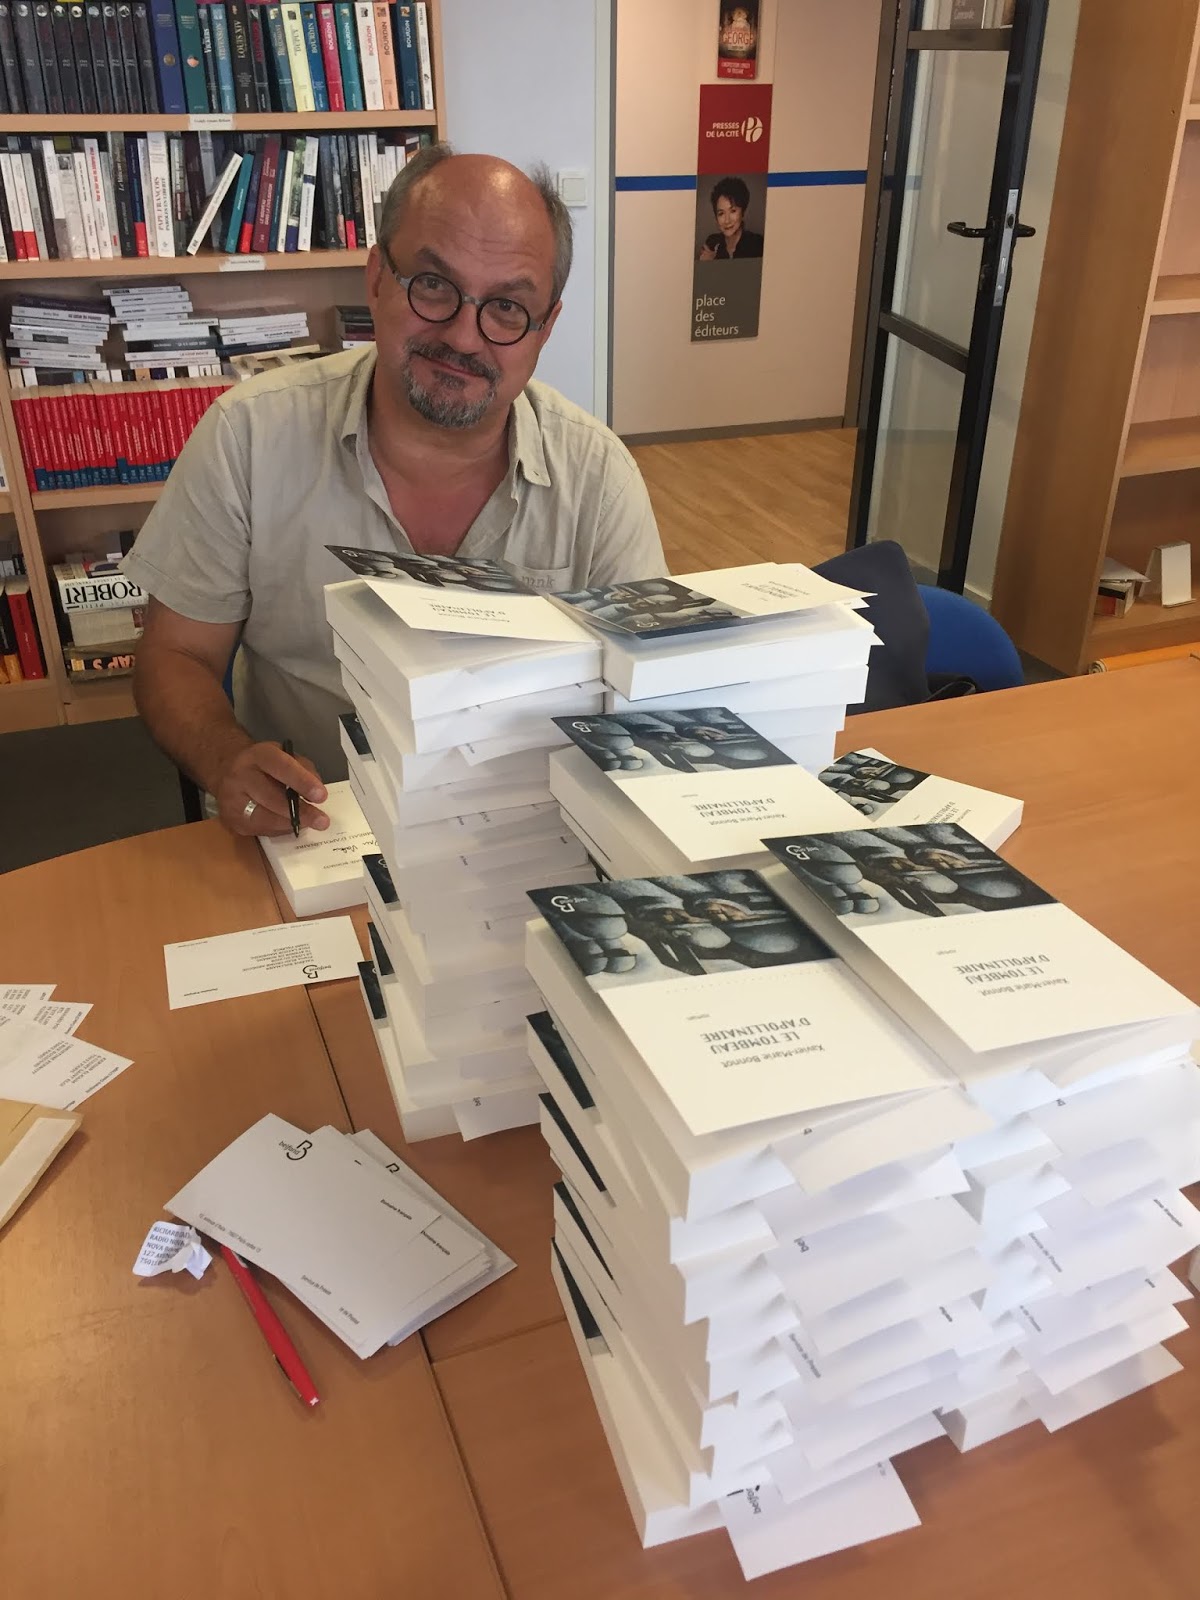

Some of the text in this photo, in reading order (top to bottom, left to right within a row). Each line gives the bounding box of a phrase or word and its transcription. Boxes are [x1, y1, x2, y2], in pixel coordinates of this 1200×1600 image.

[308, 22, 318, 54] BOURDIN
[326, 22, 334, 50] BOURDIN
[366, 25, 374, 56] BOURDIN
[382, 21, 391, 56] BOURDIN
[712, 122, 740, 130] PRESSES
[696, 294, 726, 310] place
[696, 310, 714, 322] des
[694, 324, 738, 337] éditeurs
[65, 581, 142, 604] ROBERT
[694, 798, 775, 811] D'APOLLINAIRE
[700, 807, 751, 818] TOMBEAU
[953, 954, 1050, 974] D'APOLLINAIRE
[964, 966, 1044, 985] LE TOMBEAU
[980, 978, 1069, 996] Xavier-Marie Bonnot
[700, 1017, 812, 1043] D'APOLLINAIRE
[709, 1031, 800, 1055] LE TOMBEAU
[720, 1044, 826, 1069] Xavier-Marie Bonnot
[278, 1140, 301, 1156] belfond
[146, 1242, 164, 1250] NOVA
[150, 1234, 170, 1243] RADIO
